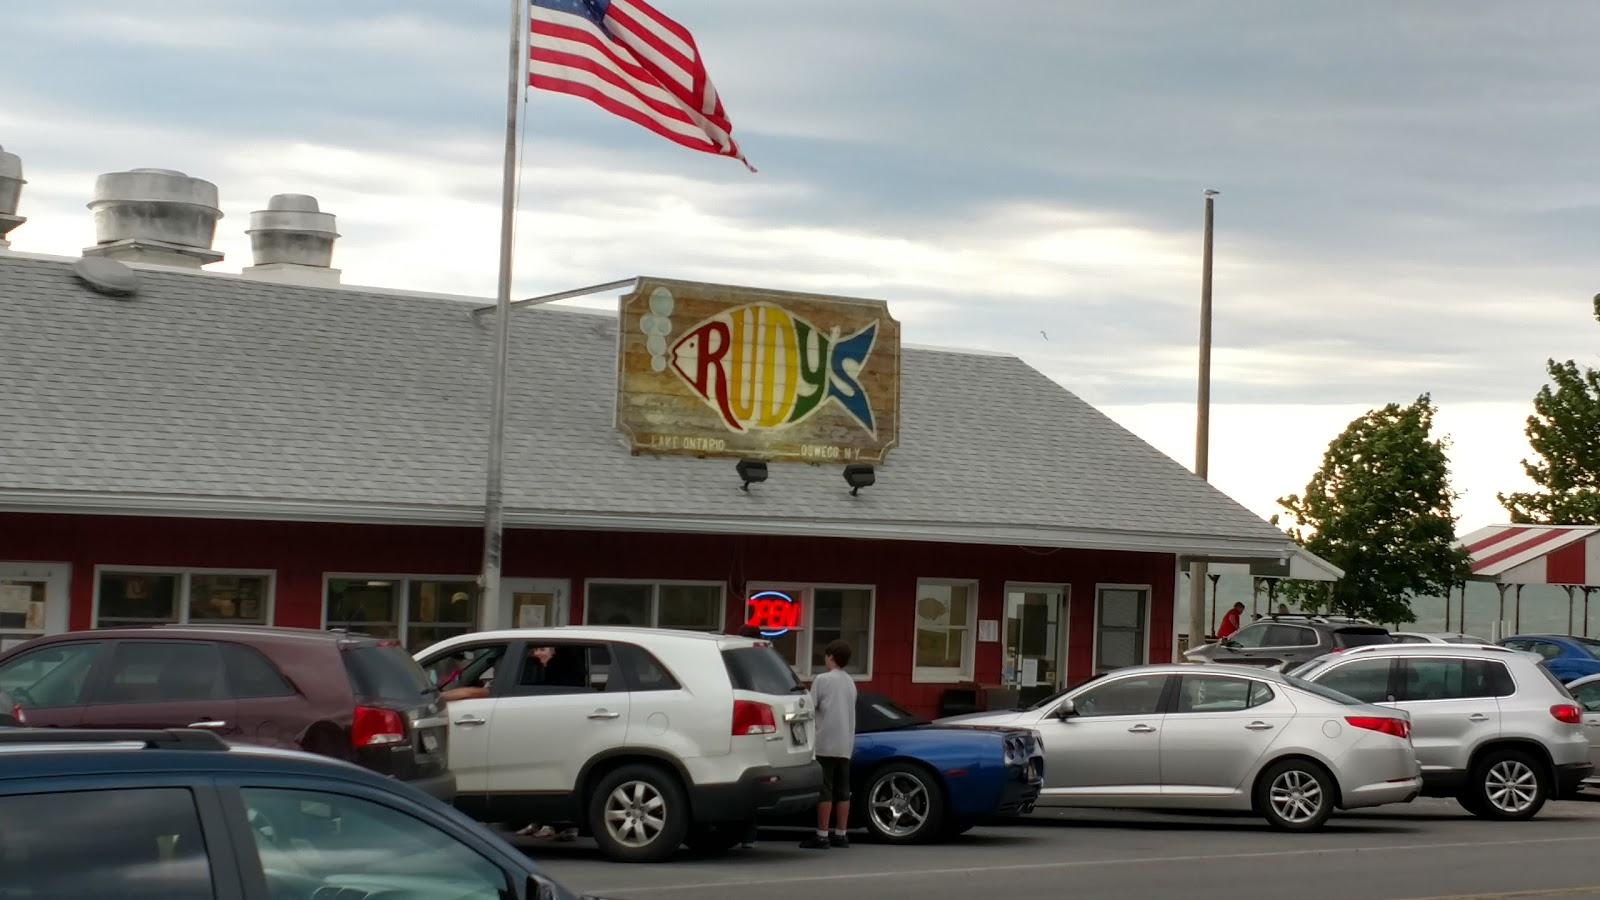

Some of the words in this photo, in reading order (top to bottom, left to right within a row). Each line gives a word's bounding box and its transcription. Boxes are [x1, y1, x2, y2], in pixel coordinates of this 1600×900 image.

[651, 434, 679, 449] LAKE
[683, 437, 725, 451] ONTARIO
[800, 444, 840, 458] OSWEGO
[747, 599, 801, 628] OPEN
